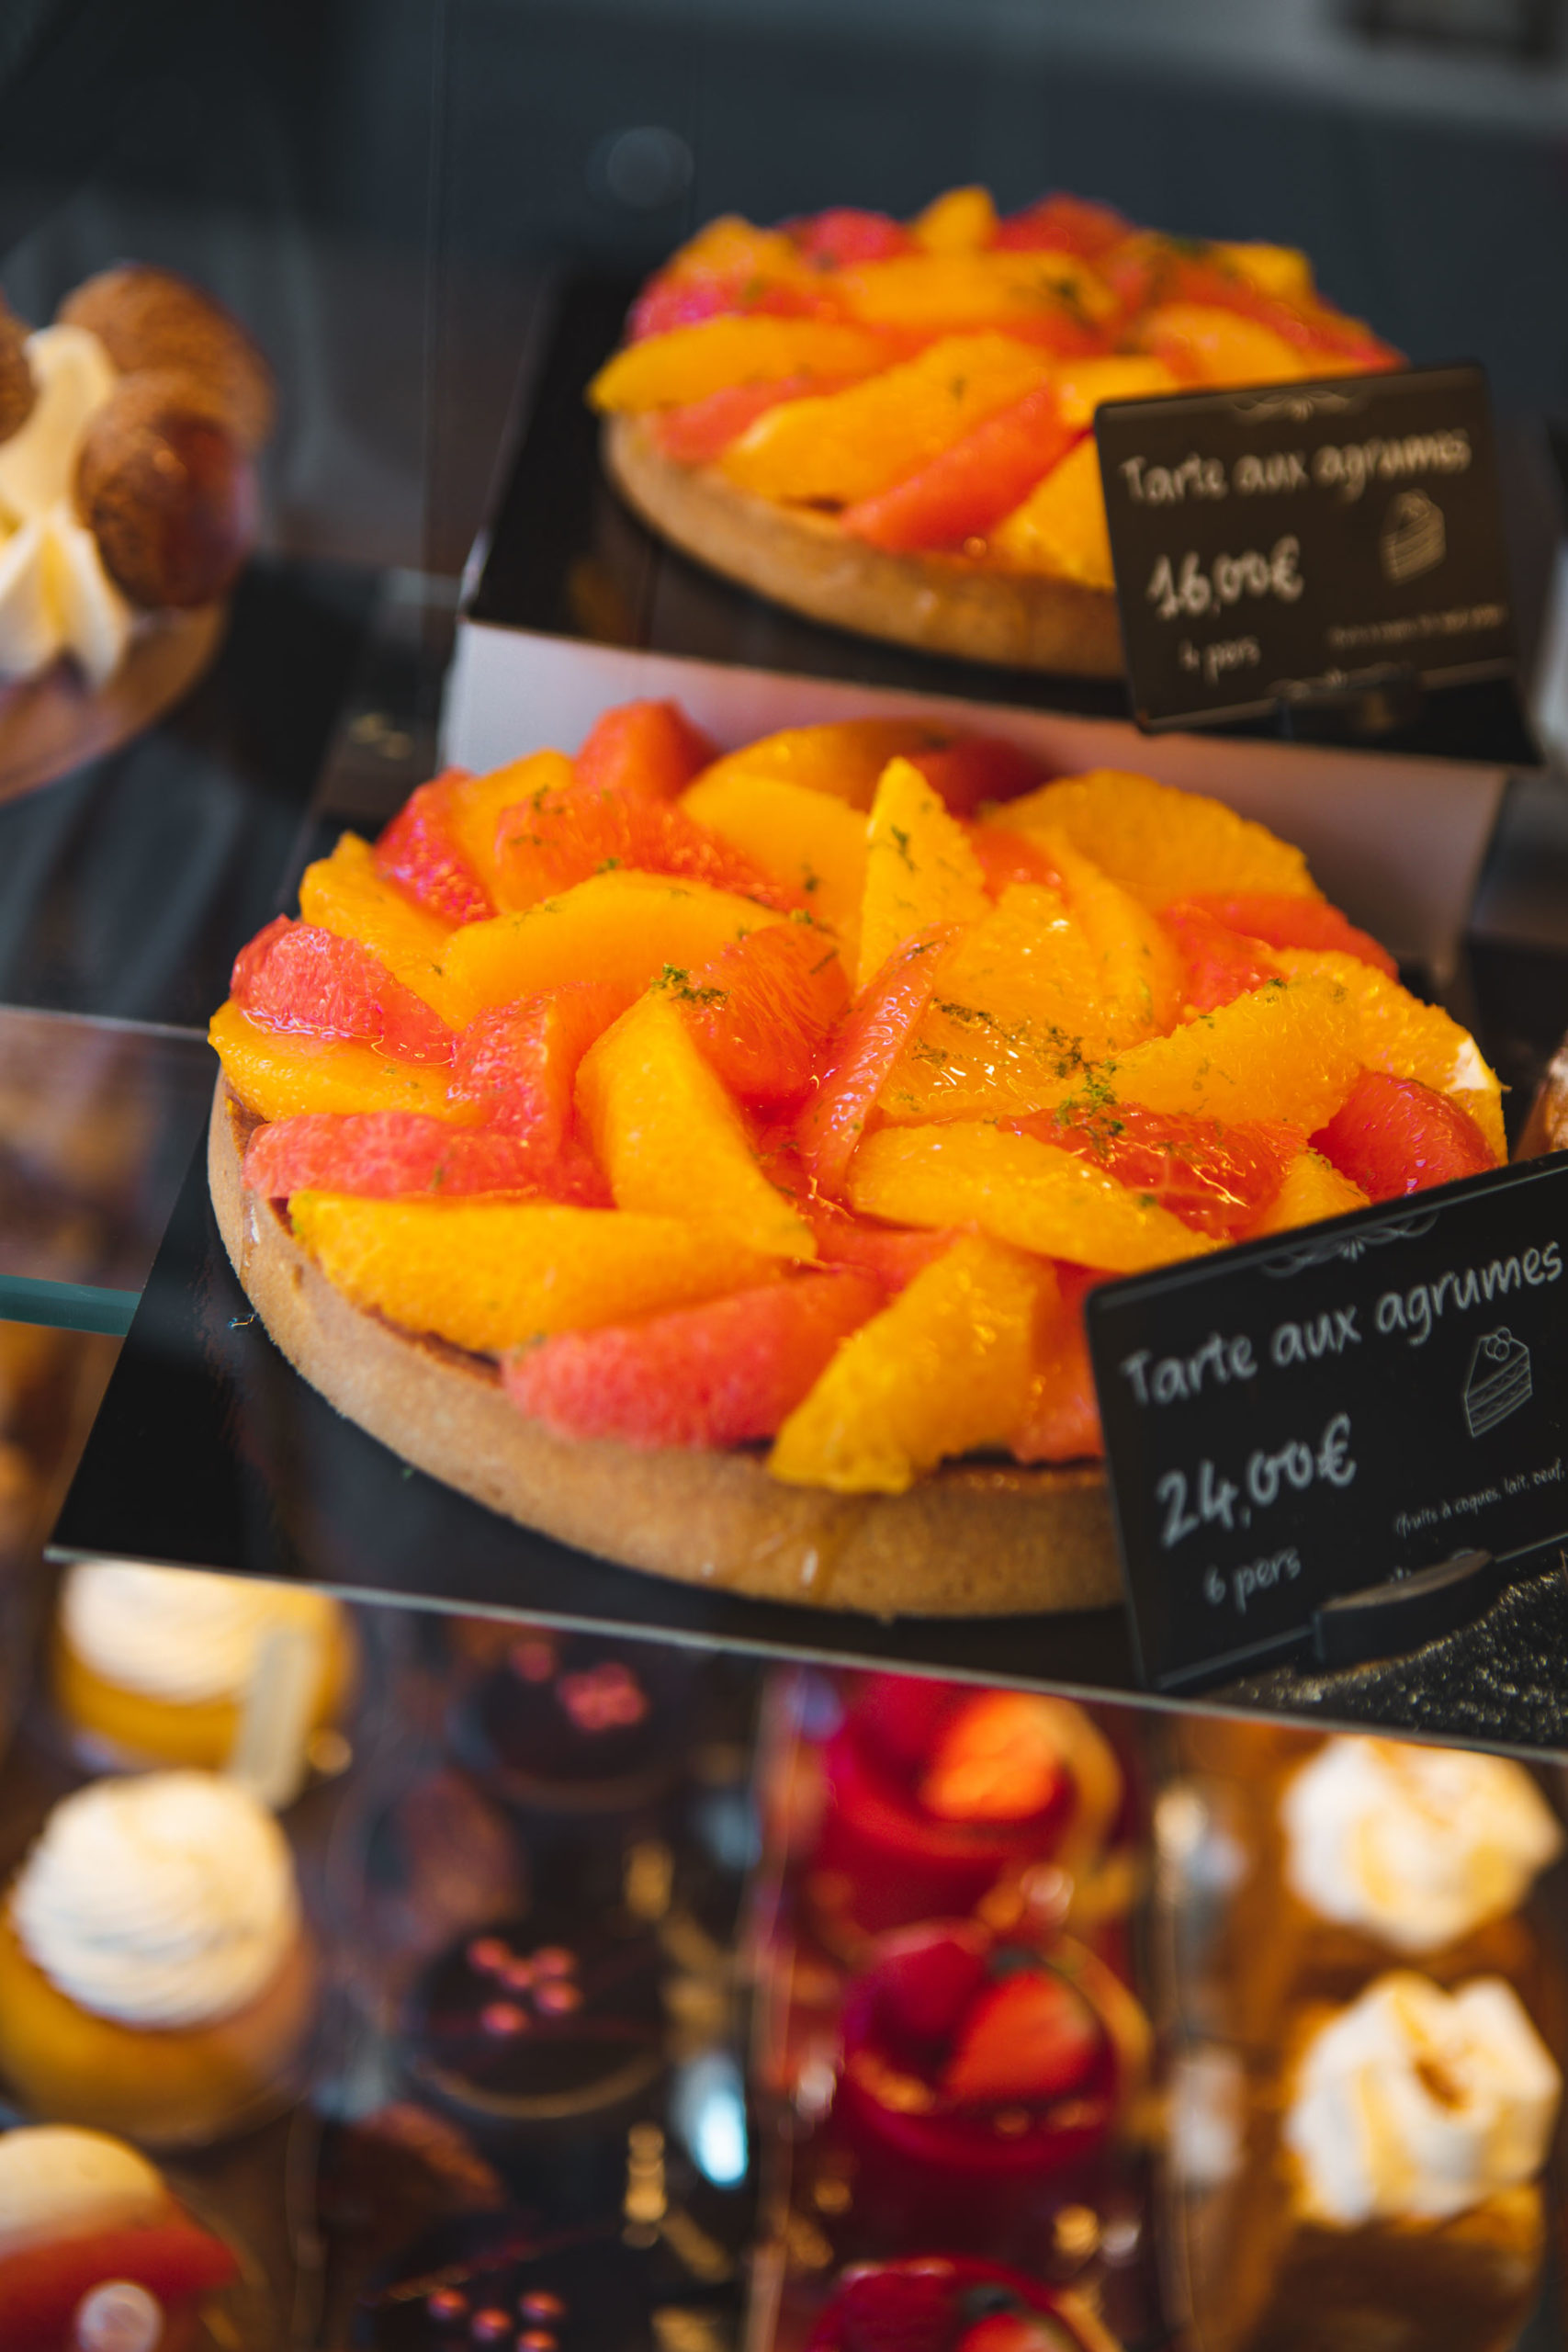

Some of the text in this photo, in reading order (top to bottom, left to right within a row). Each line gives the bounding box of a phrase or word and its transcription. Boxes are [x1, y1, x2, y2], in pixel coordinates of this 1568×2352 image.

[1122, 455, 1226, 503] Tarte
[1234, 453, 1308, 494] aux
[1121, 1241, 1562, 1405] Tarte aux agrumes
[1156, 1412, 1357, 1548] 24,00€
[1205, 1547, 1302, 1614] 6 pers
